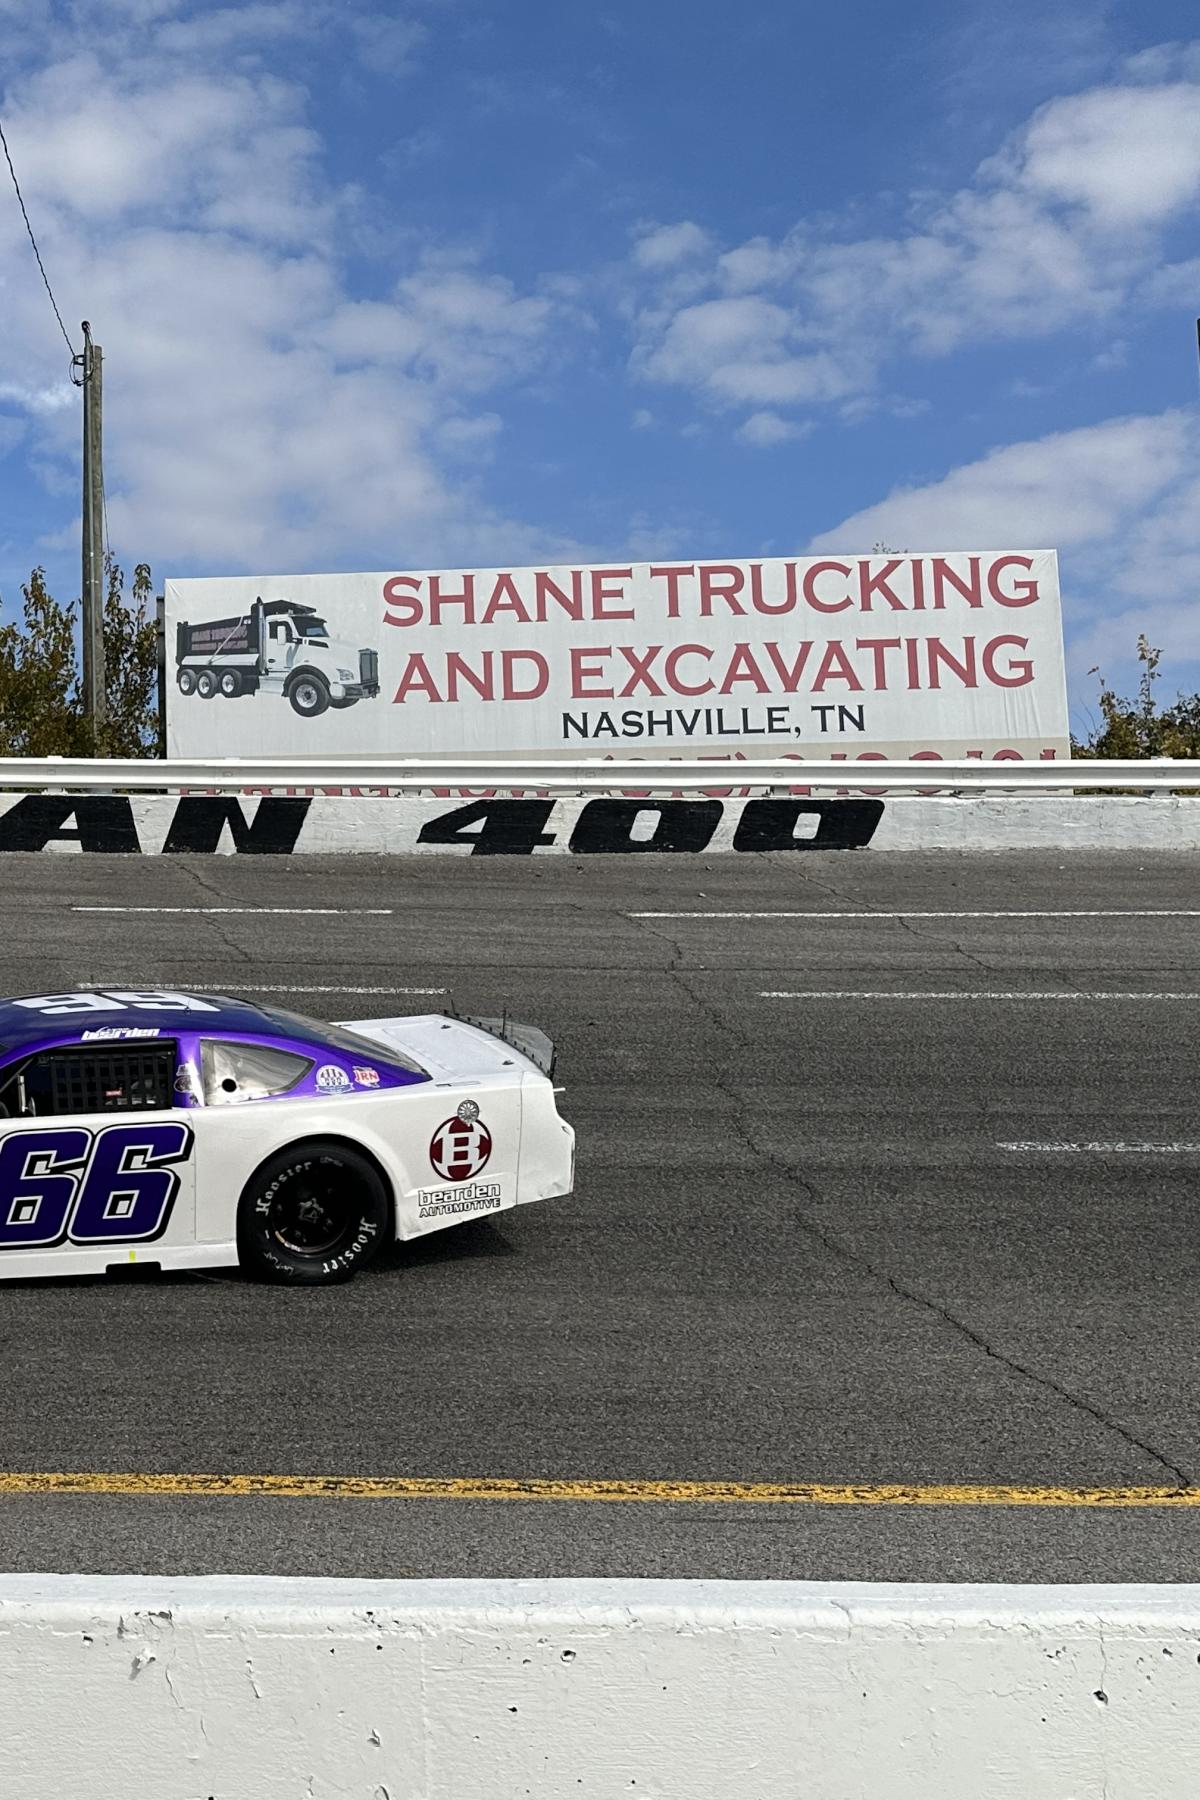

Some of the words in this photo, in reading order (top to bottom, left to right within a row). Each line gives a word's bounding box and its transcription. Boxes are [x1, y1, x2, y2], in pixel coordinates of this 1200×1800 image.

[382, 567, 635, 628] SHANE
[649, 555, 1041, 618] TRUCKING
[392, 649, 550, 704] AND
[569, 633, 1036, 700] EXCAVATING
[563, 705, 801, 740] NASHVILLE,
[810, 704, 867, 733] TN
[416, 798, 885, 856] 400
[418, 1183, 501, 1206] bearden
[419, 1197, 501, 1218] AUTOMOTIVE
[322, 1216, 377, 1273] Hoosier
